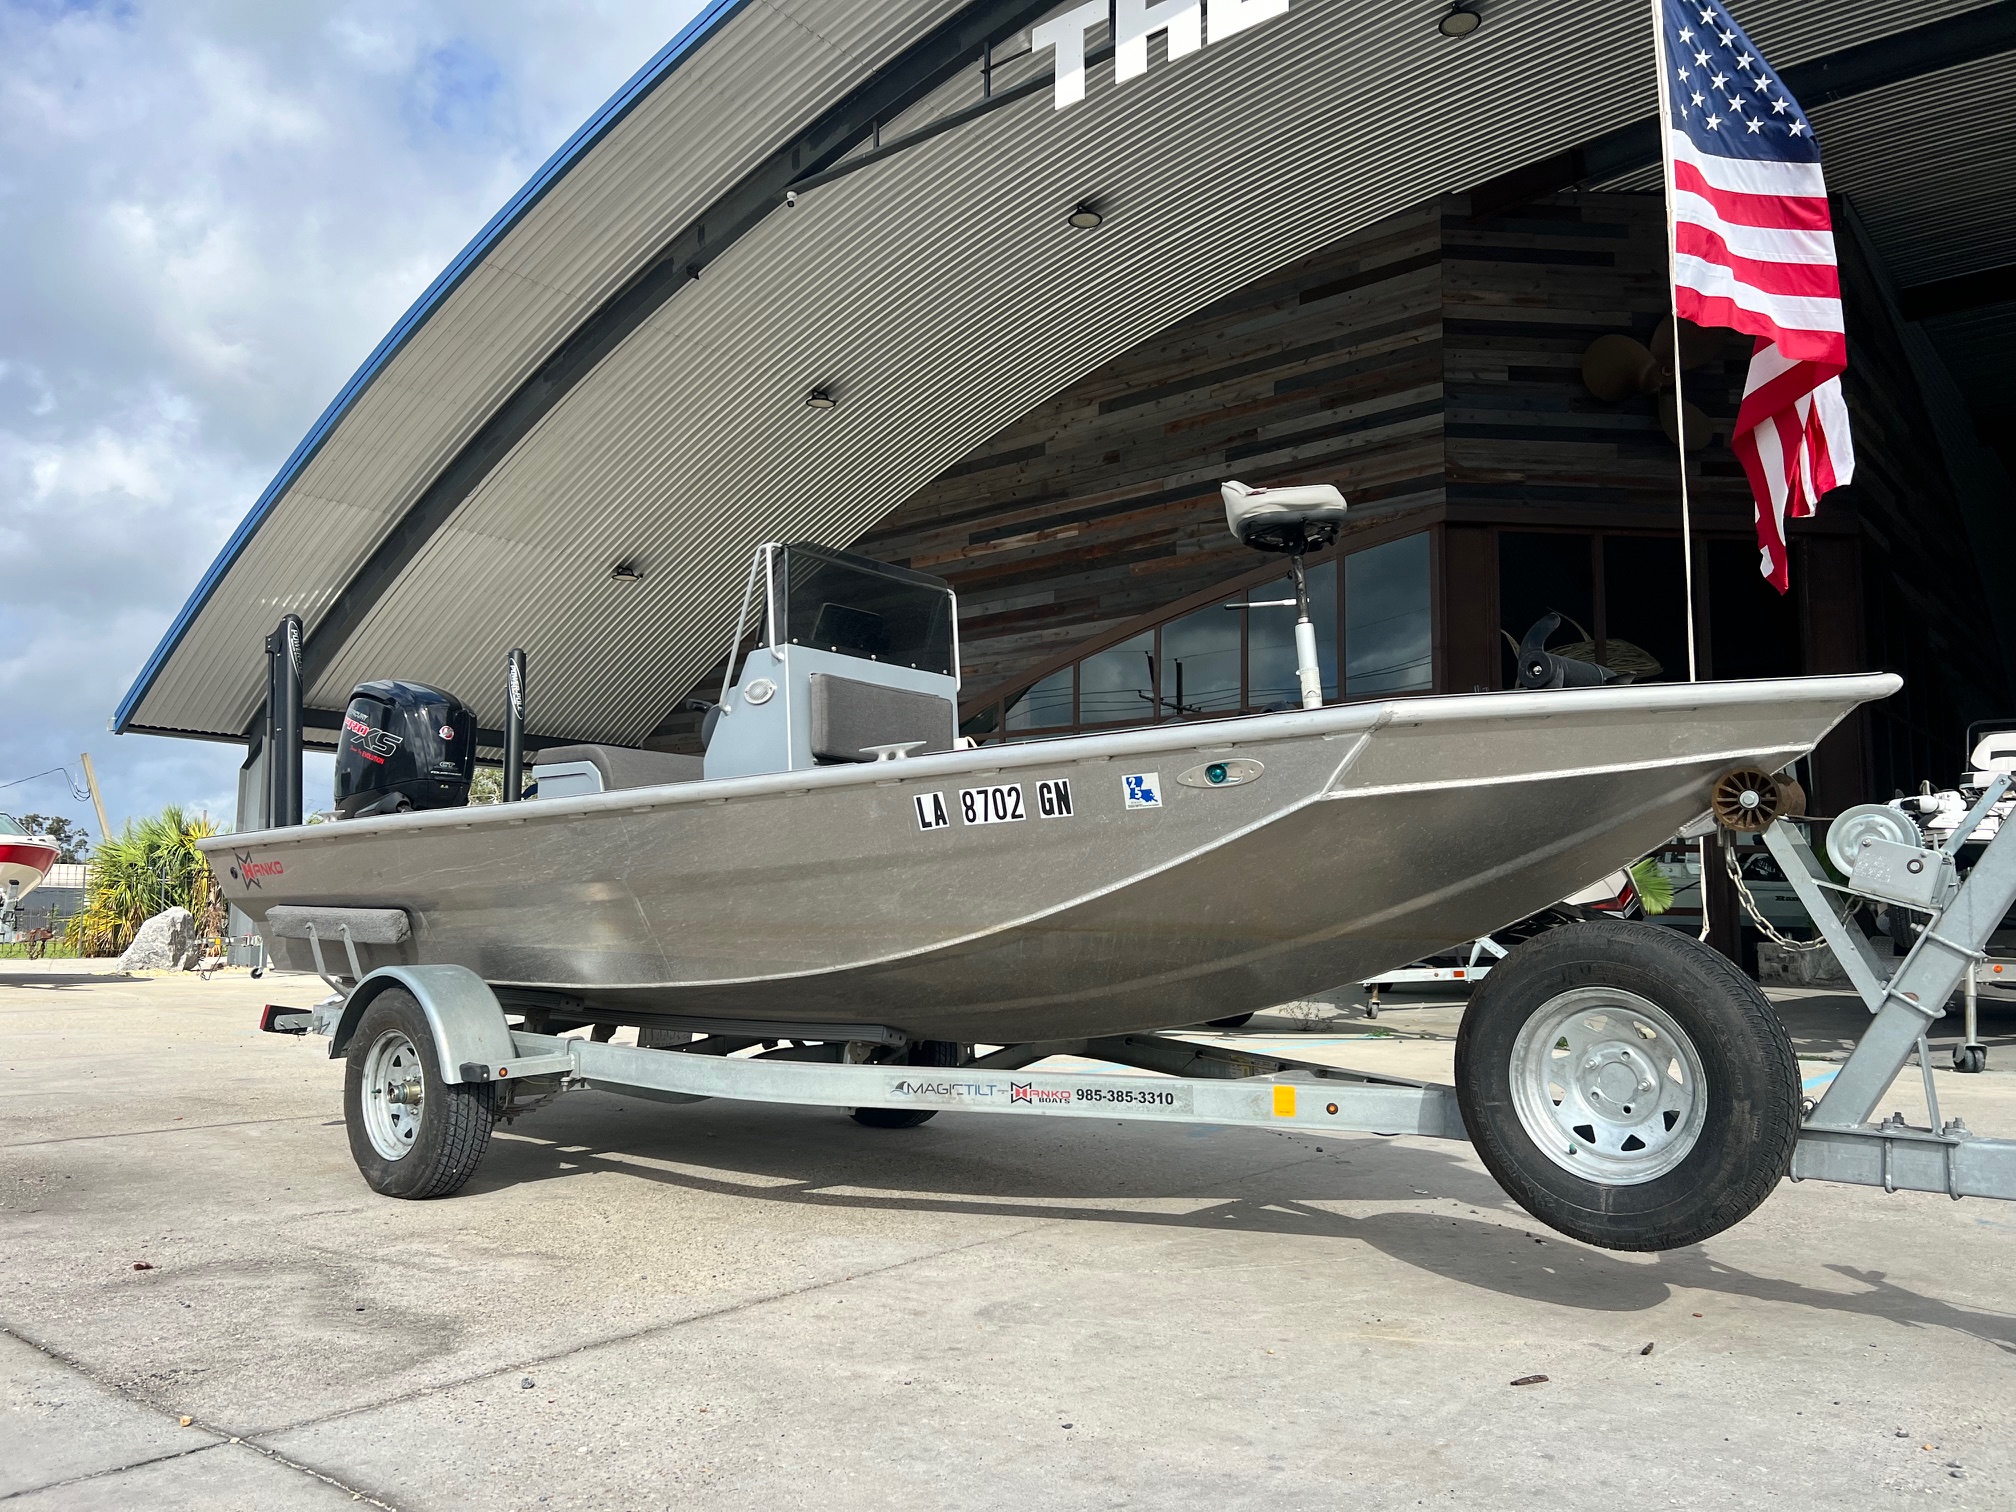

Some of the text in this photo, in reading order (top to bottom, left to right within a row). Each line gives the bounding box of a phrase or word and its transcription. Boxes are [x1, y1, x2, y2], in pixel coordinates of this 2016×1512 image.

[350, 727, 404, 757] XS
[916, 780, 1072, 829] LA 8702 GN
[1076, 1088, 1174, 1105] 985-385-3310
